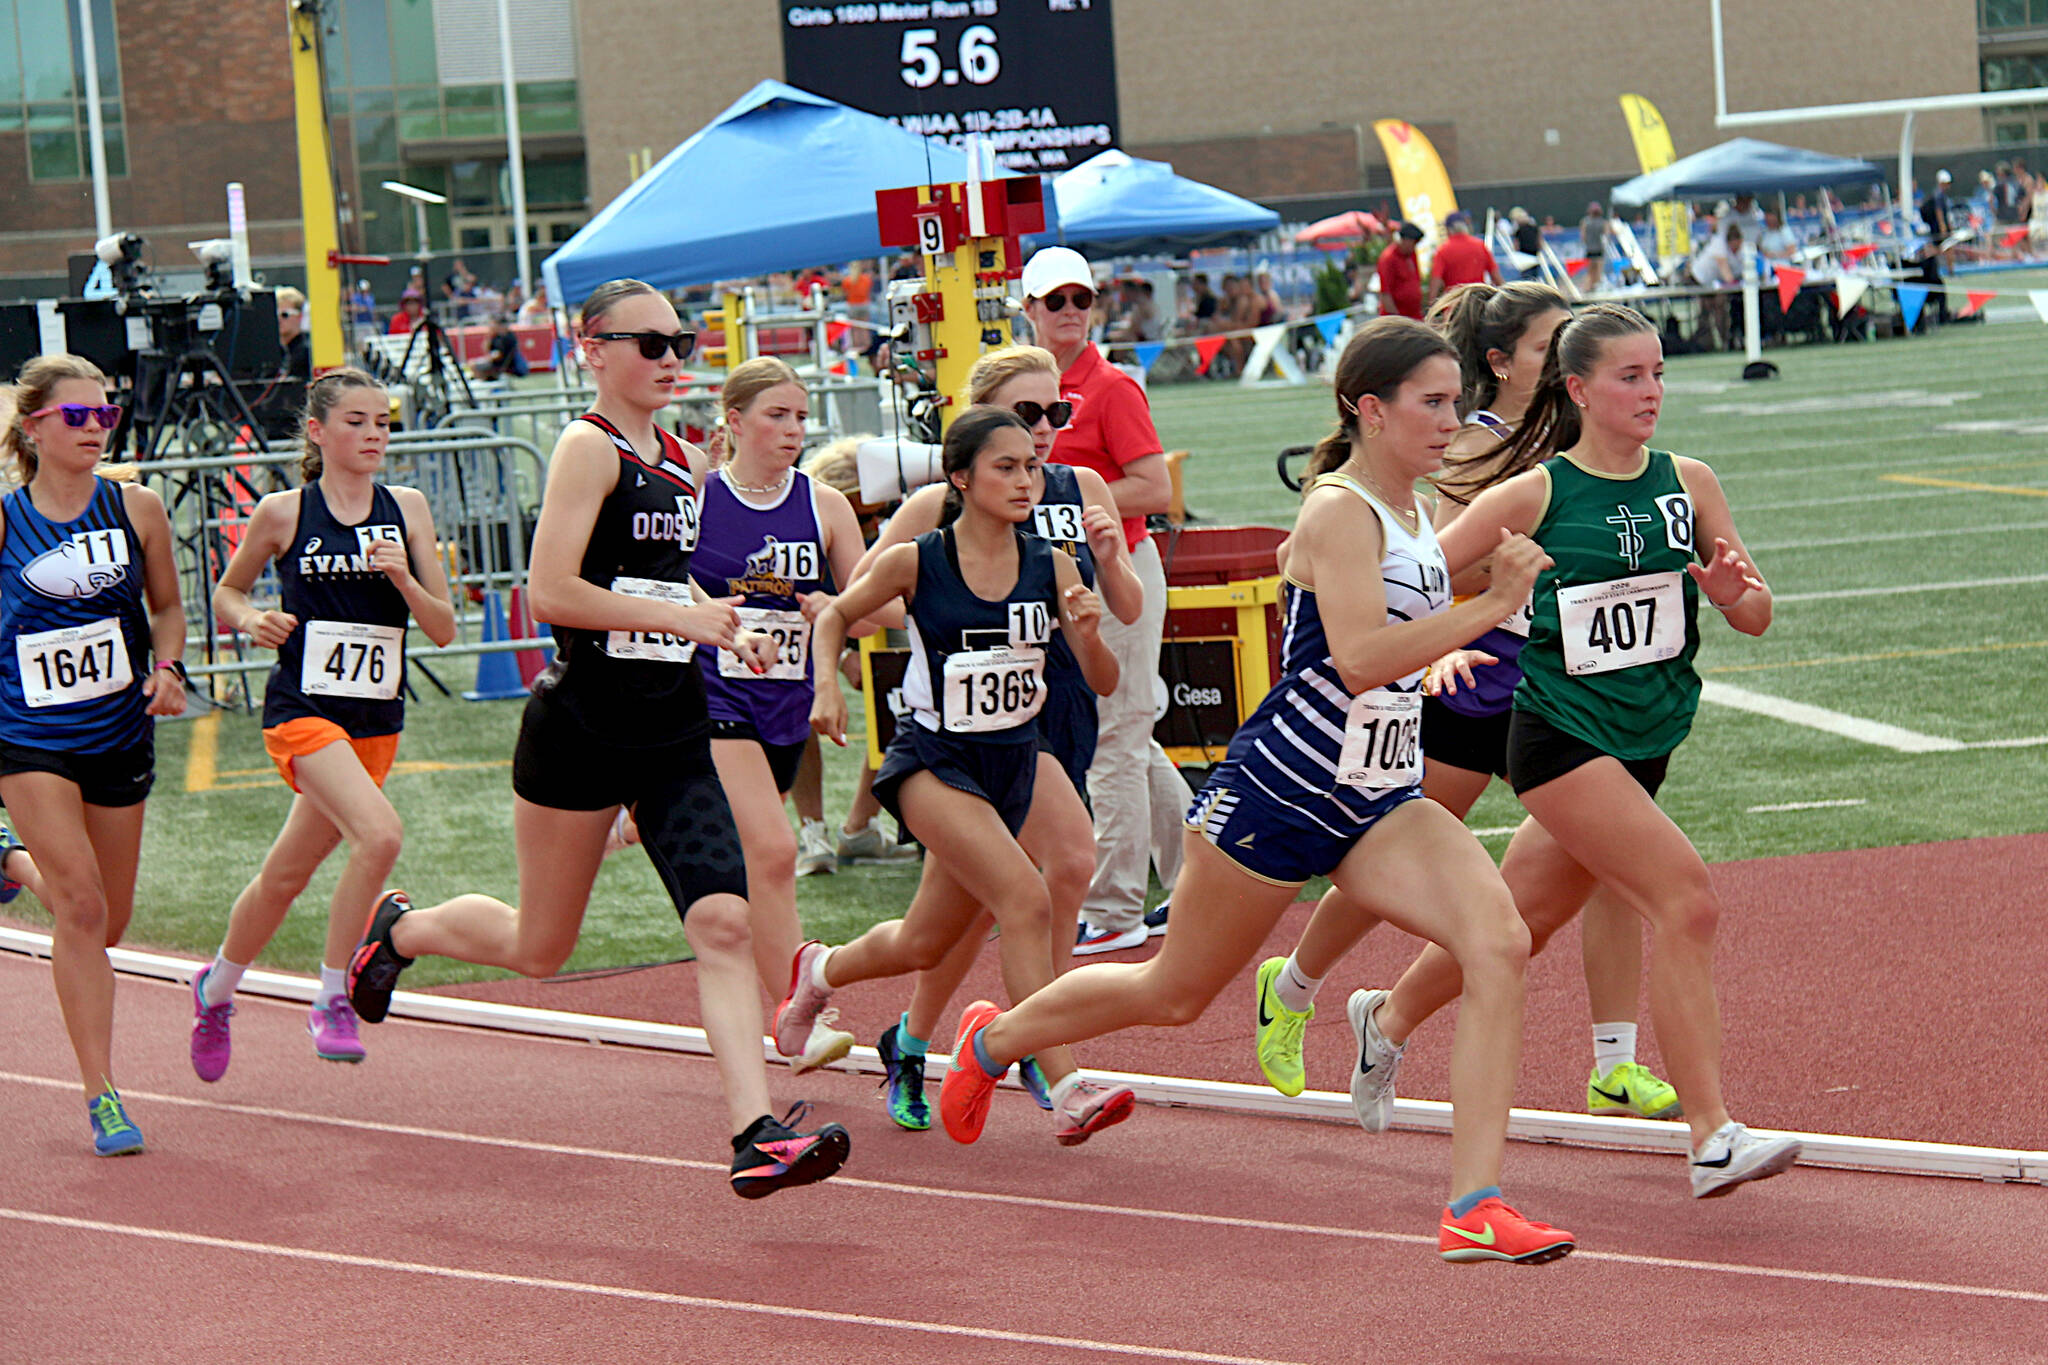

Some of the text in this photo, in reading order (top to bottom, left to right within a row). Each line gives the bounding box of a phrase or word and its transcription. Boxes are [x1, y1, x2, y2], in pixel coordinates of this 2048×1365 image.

[788, 8, 833, 26] Girls
[879, 3, 929, 20] Meter
[931, 1, 969, 17] Run
[900, 25, 1001, 88] 5.6
[923, 218, 940, 251] 9
[1038, 506, 1078, 539] 13
[1666, 497, 1691, 546] 8
[78, 534, 117, 564] 11
[781, 544, 812, 577] 16
[1012, 604, 1046, 641] 10
[1588, 597, 1657, 654] 407
[33, 639, 114, 690] 1647
[324, 642, 385, 684] 476
[959, 668, 1038, 716] 1369
[1173, 682, 1222, 707] Gesa
